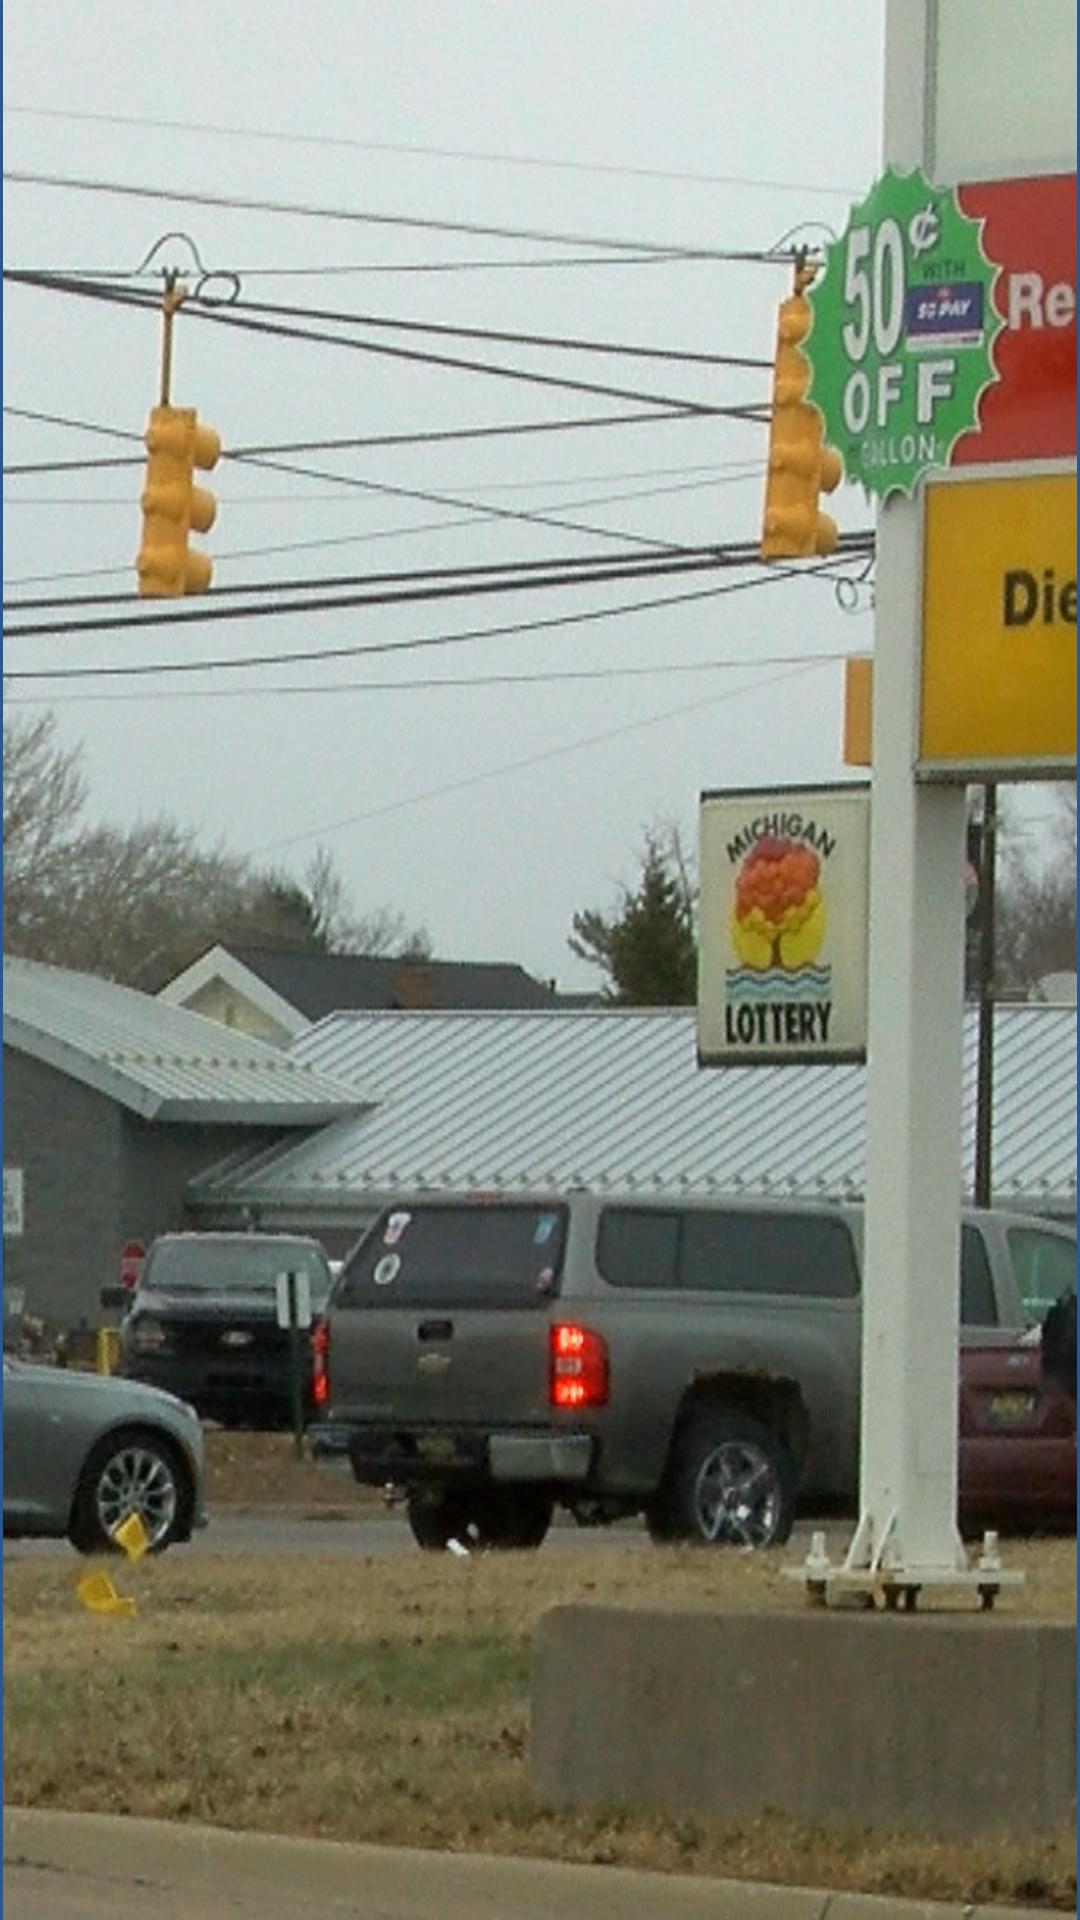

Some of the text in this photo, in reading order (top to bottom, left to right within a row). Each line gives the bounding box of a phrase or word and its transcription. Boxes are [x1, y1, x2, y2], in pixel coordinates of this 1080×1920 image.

[922, 260, 965, 279] WITH
[939, 298, 972, 317] PAY
[1009, 272, 1076, 329] Re
[843, 359, 955, 434] OFF
[861, 434, 935, 471] GALLON
[726, 812, 837, 863] MICHIGAN
[725, 1001, 832, 1044] LOTTERY
